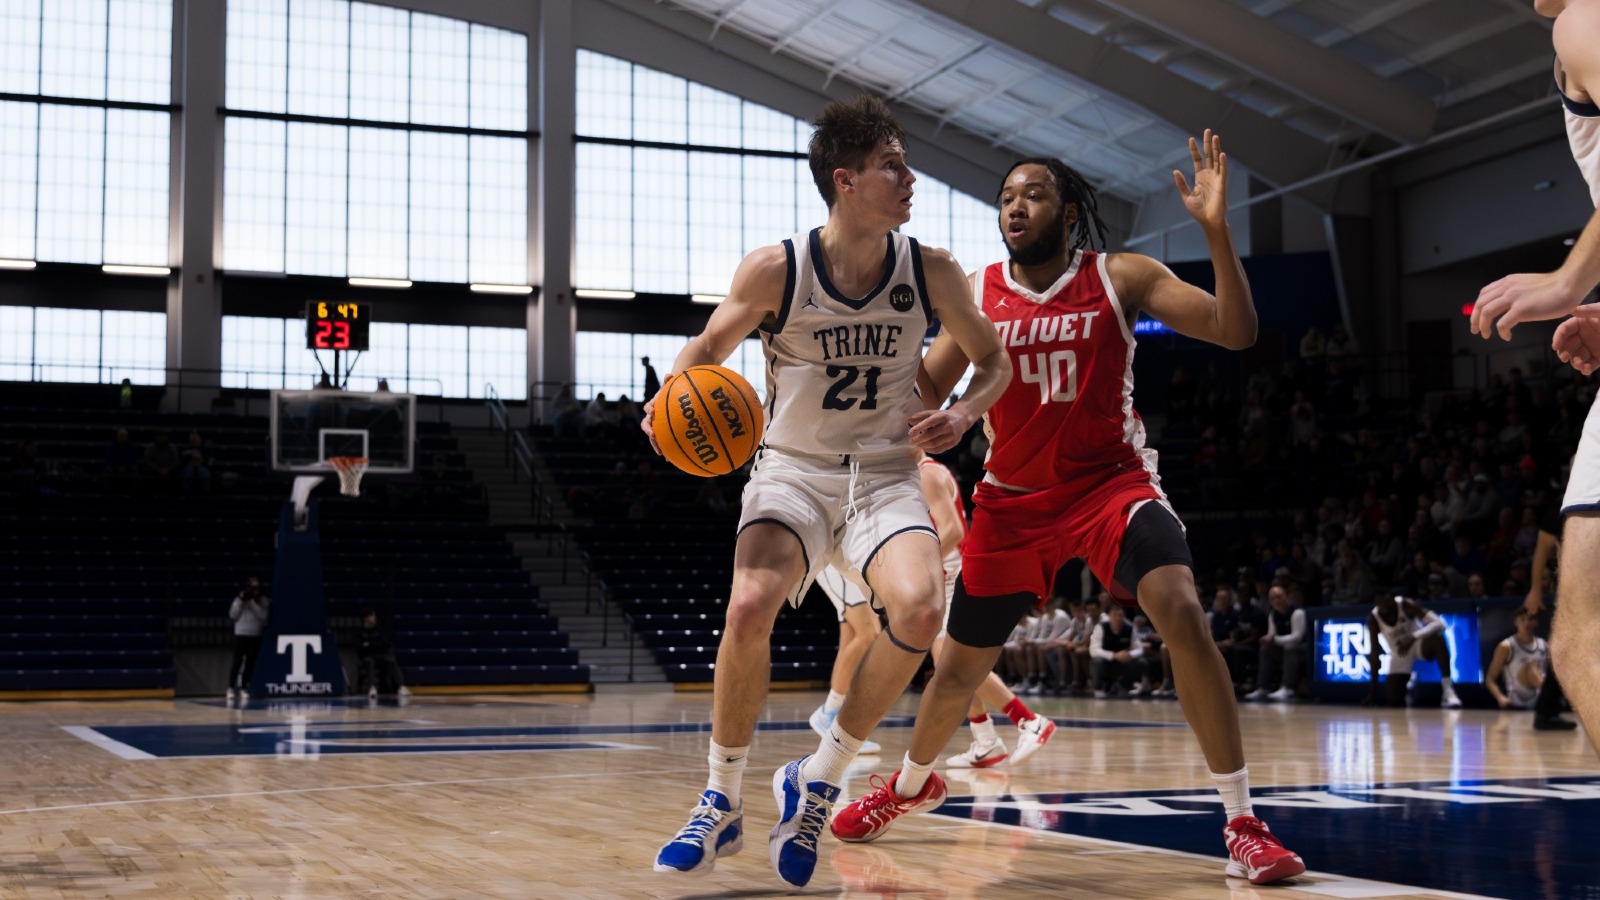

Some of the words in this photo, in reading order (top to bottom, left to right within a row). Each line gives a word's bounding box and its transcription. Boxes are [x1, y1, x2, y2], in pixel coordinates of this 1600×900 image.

[892, 292, 913, 304] FGI
[315, 321, 350, 348] 23
[813, 323, 902, 361] TRINE
[822, 365, 882, 411] 21
[1019, 350, 1077, 405] 40
[678, 393, 719, 466] Wilson
[710, 386, 745, 439] NCAA
[277, 634, 322, 683] T
[1323, 622, 1392, 655] TRI
[265, 682, 332, 694] THUNDER
